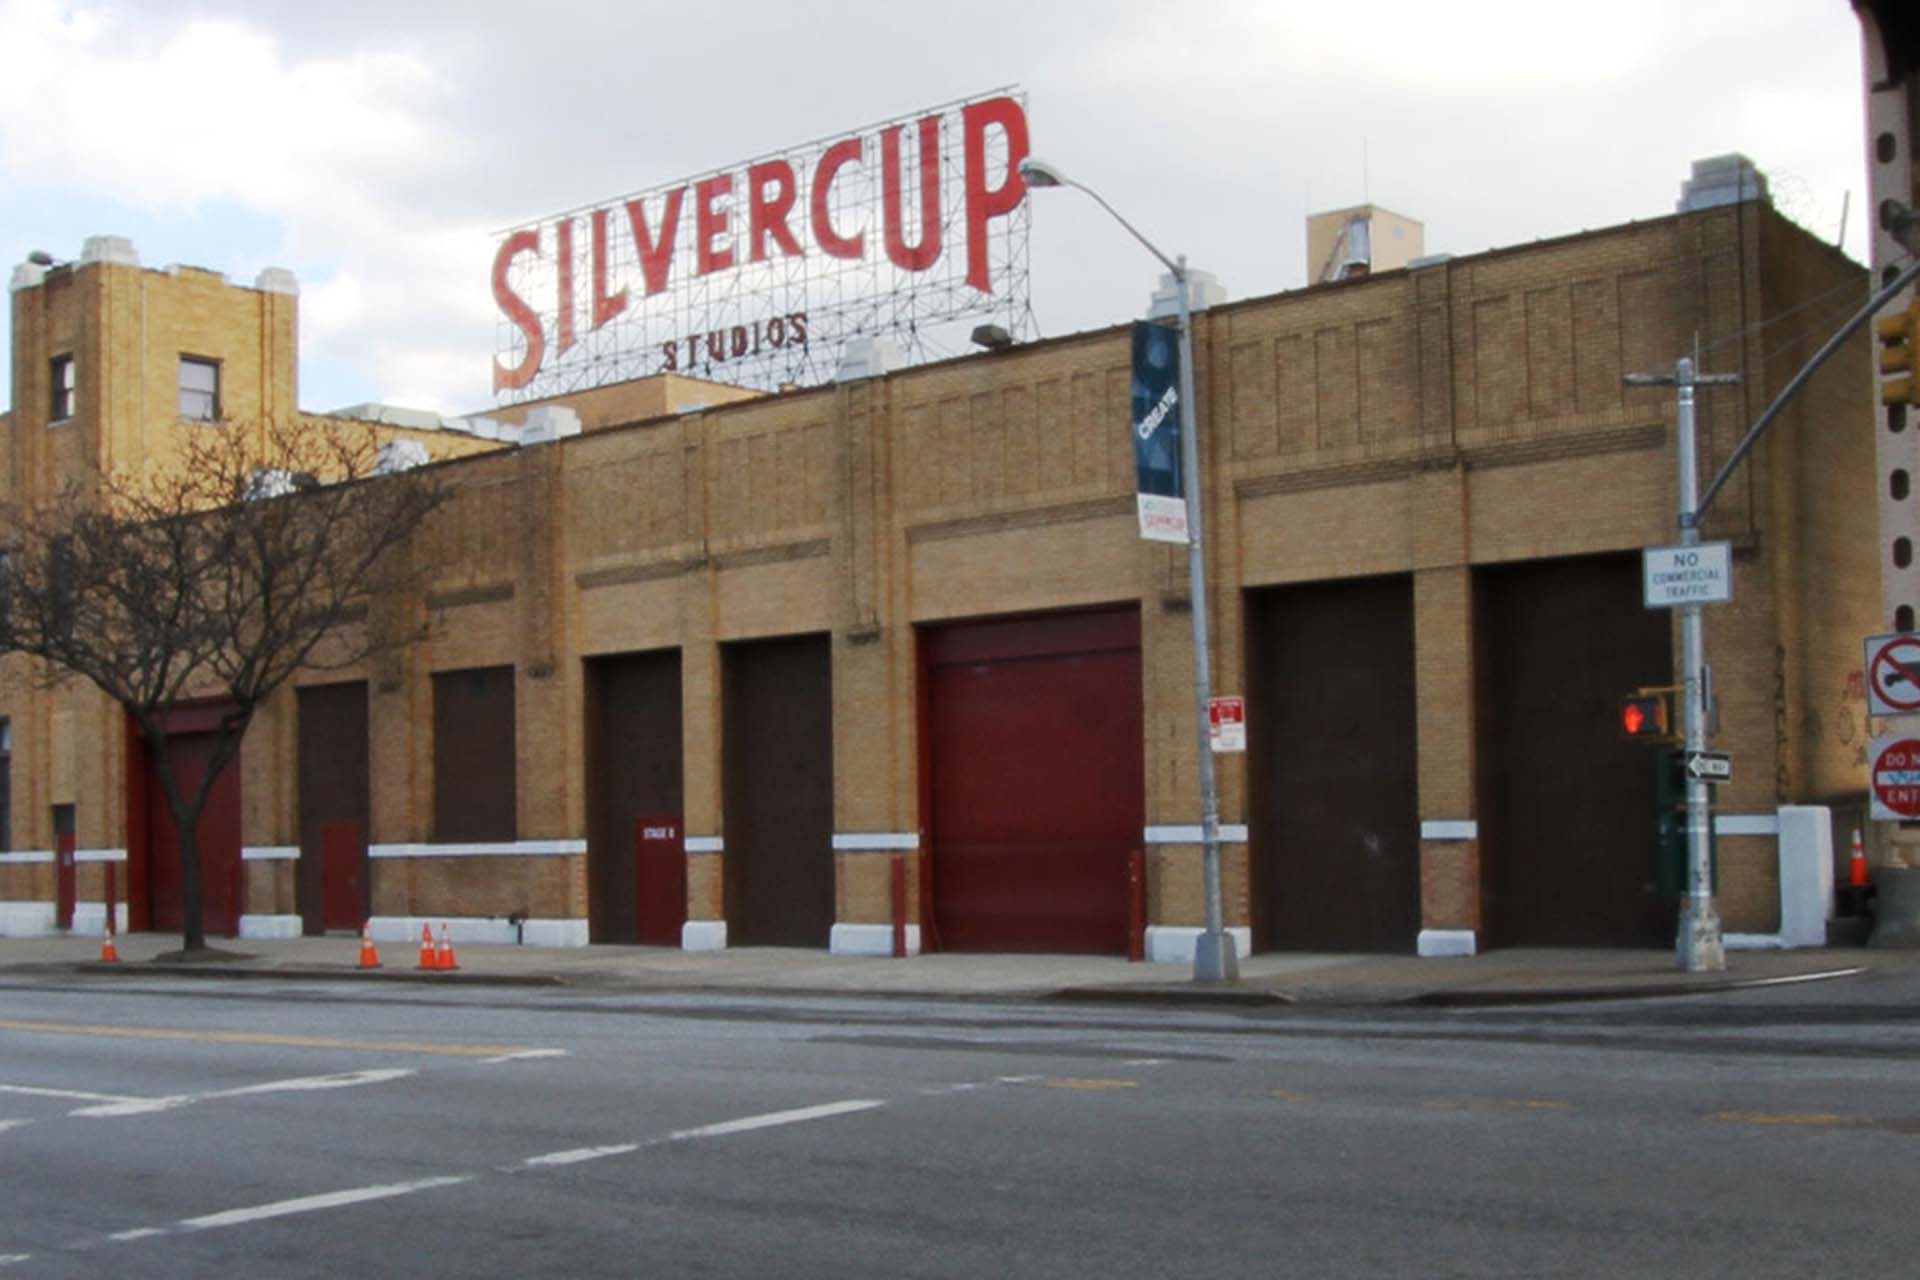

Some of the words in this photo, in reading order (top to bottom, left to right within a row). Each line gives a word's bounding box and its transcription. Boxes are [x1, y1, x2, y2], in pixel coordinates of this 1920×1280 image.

[491, 97, 1029, 394] SILVERCUP
[663, 312, 808, 370] STUDIOS
[1673, 552, 1698, 567] NO
[1653, 568, 1719, 585] COMMERCIAL
[1666, 584, 1709, 597] TRAFFIC
[1886, 752, 1905, 767] DO
[1888, 790, 1920, 804] ENT
